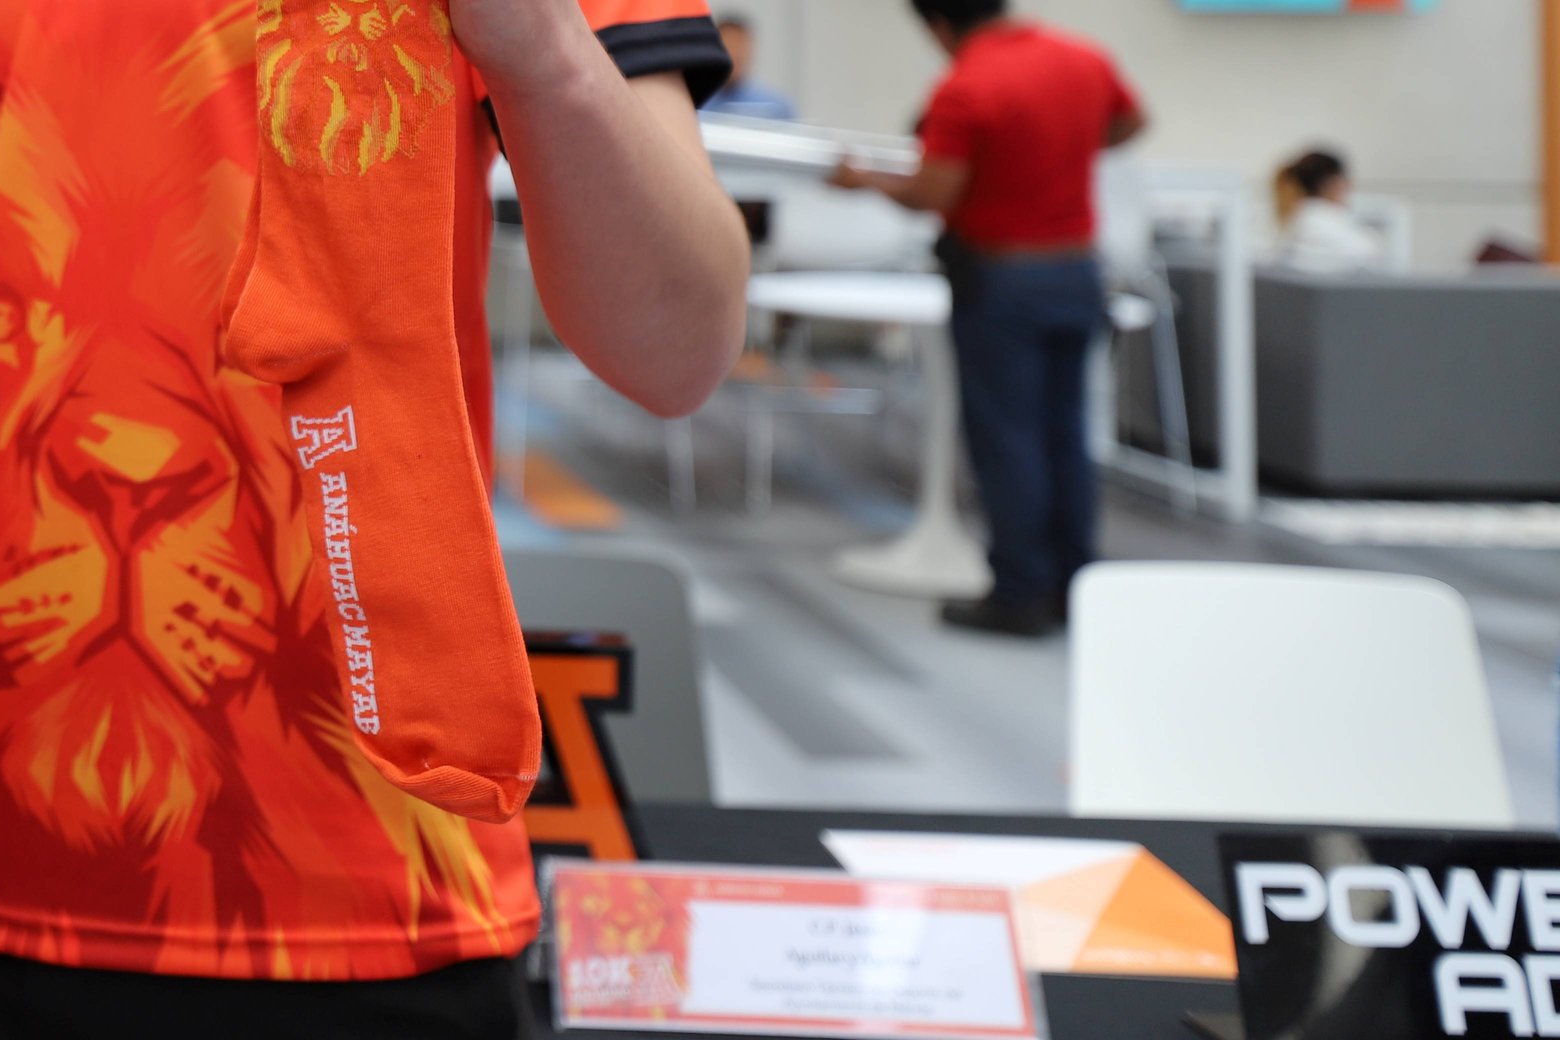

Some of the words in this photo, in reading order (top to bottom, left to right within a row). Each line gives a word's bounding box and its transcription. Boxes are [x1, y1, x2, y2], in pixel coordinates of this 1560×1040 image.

[319, 471, 367, 623] ANÁHUAC
[342, 623, 382, 737] MAYAB
[1234, 862, 1559, 950] POWE
